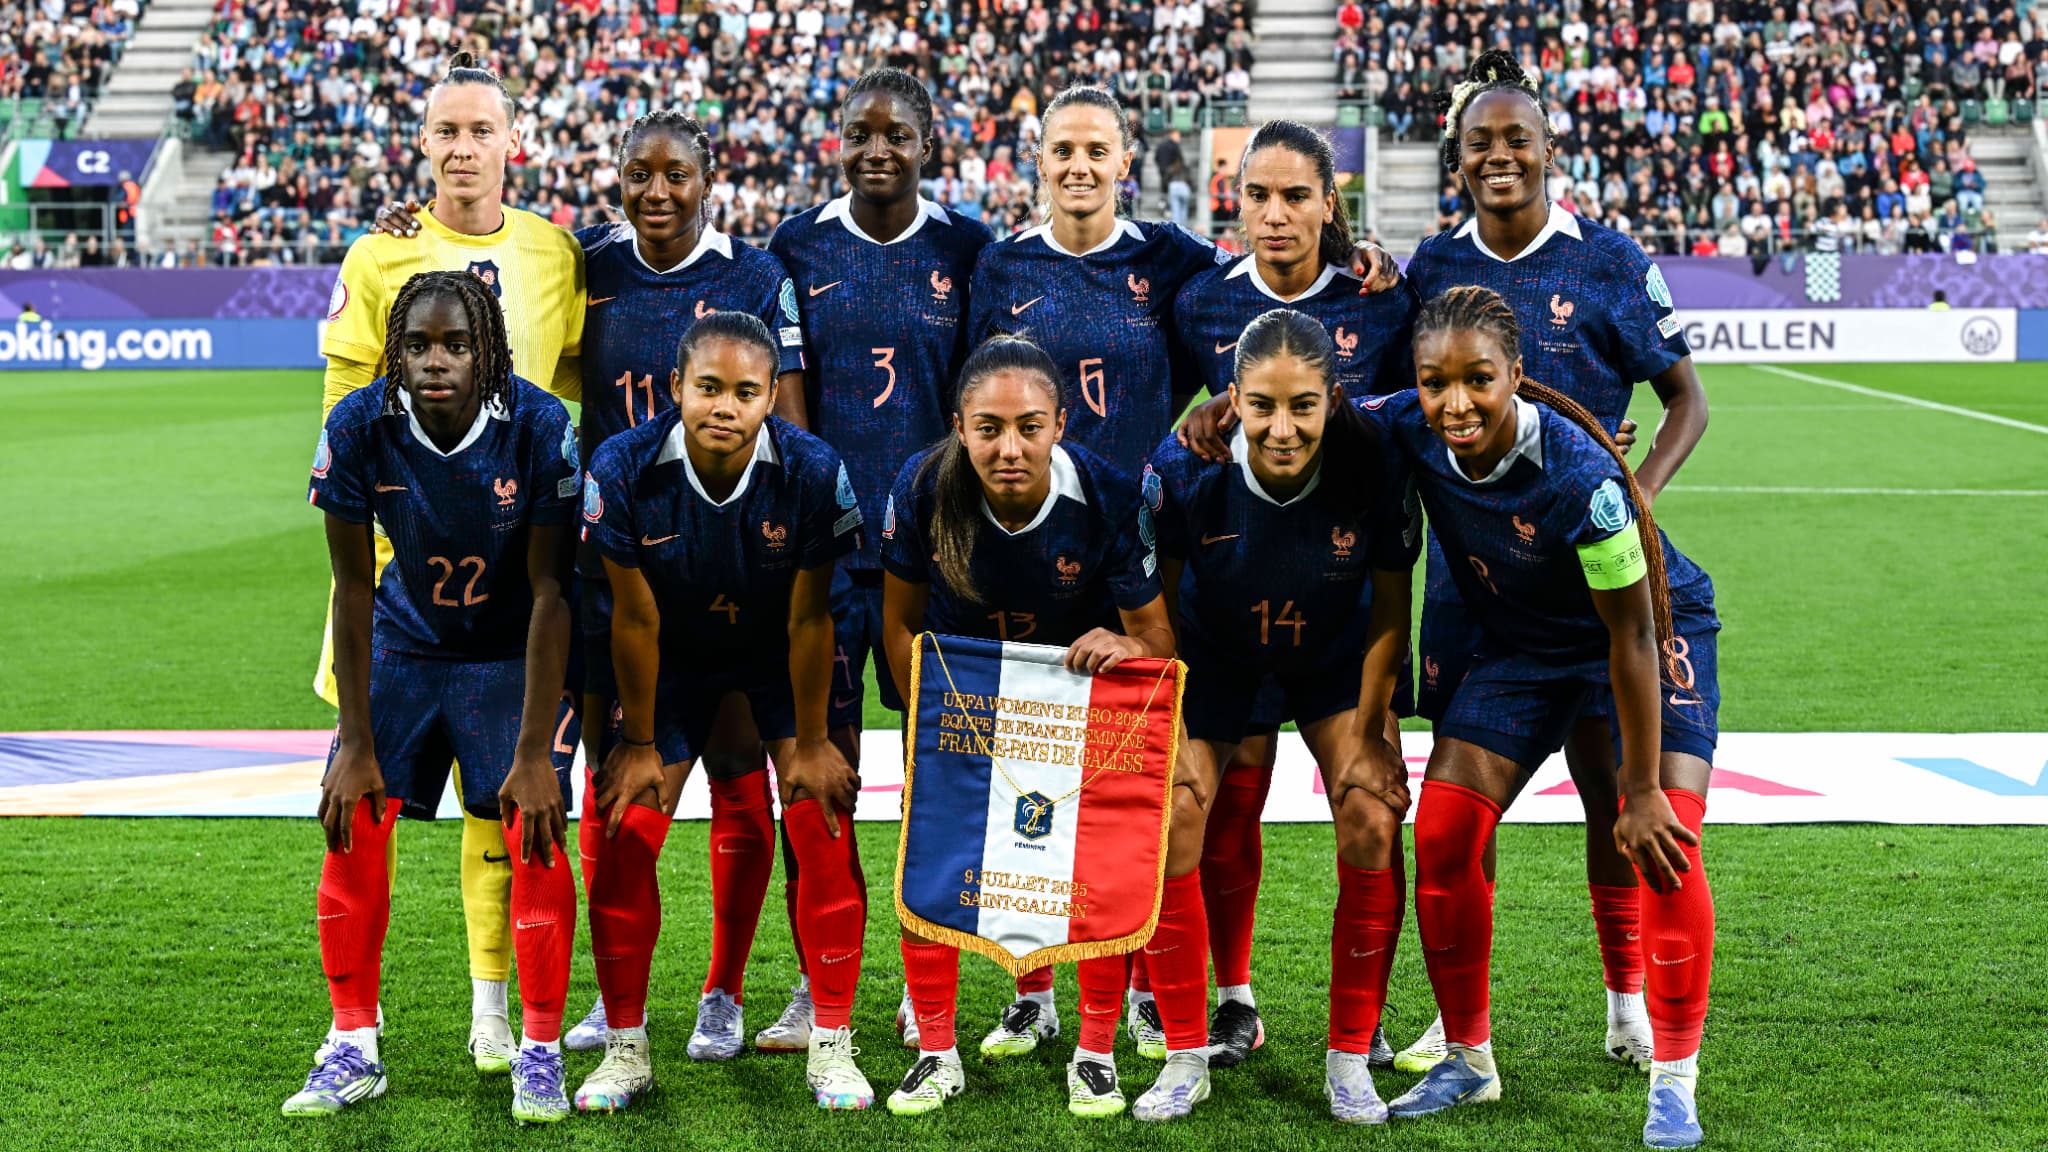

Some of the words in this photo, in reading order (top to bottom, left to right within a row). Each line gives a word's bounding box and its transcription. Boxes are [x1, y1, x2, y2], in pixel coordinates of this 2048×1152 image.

[76, 150, 111, 174] C2
[1685, 321, 1835, 350] GALLEN
[872, 347, 896, 408] 3
[1079, 357, 1106, 418] 6
[615, 371, 655, 428] 11
[427, 556, 490, 607] 22
[709, 593, 740, 624] 4
[986, 609, 1038, 640] 13
[1250, 600, 1307, 647] 14
[943, 692, 986, 711] UEFA
[988, 696, 1064, 720] WOMEN'S
[1066, 705, 1112, 724] EURO
[1115, 711, 1149, 729] 2025
[940, 713, 992, 733] EQUIPE
[995, 717, 1015, 735] DE
[1016, 720, 1073, 742] FRANCE
[1075, 727, 1146, 750] FEMININE
[938, 731, 1050, 763] FRANCE-PAYS
[1051, 743, 1076, 766] DE
[1078, 748, 1145, 774] GALLES
[1019, 824, 1046, 833] FRNCE
[964, 869, 974, 884] 9
[976, 869, 1050, 893] JUILLET
[1051, 880, 1088, 897] 2025
[959, 890, 1089, 919] SAINT-GALLEN
